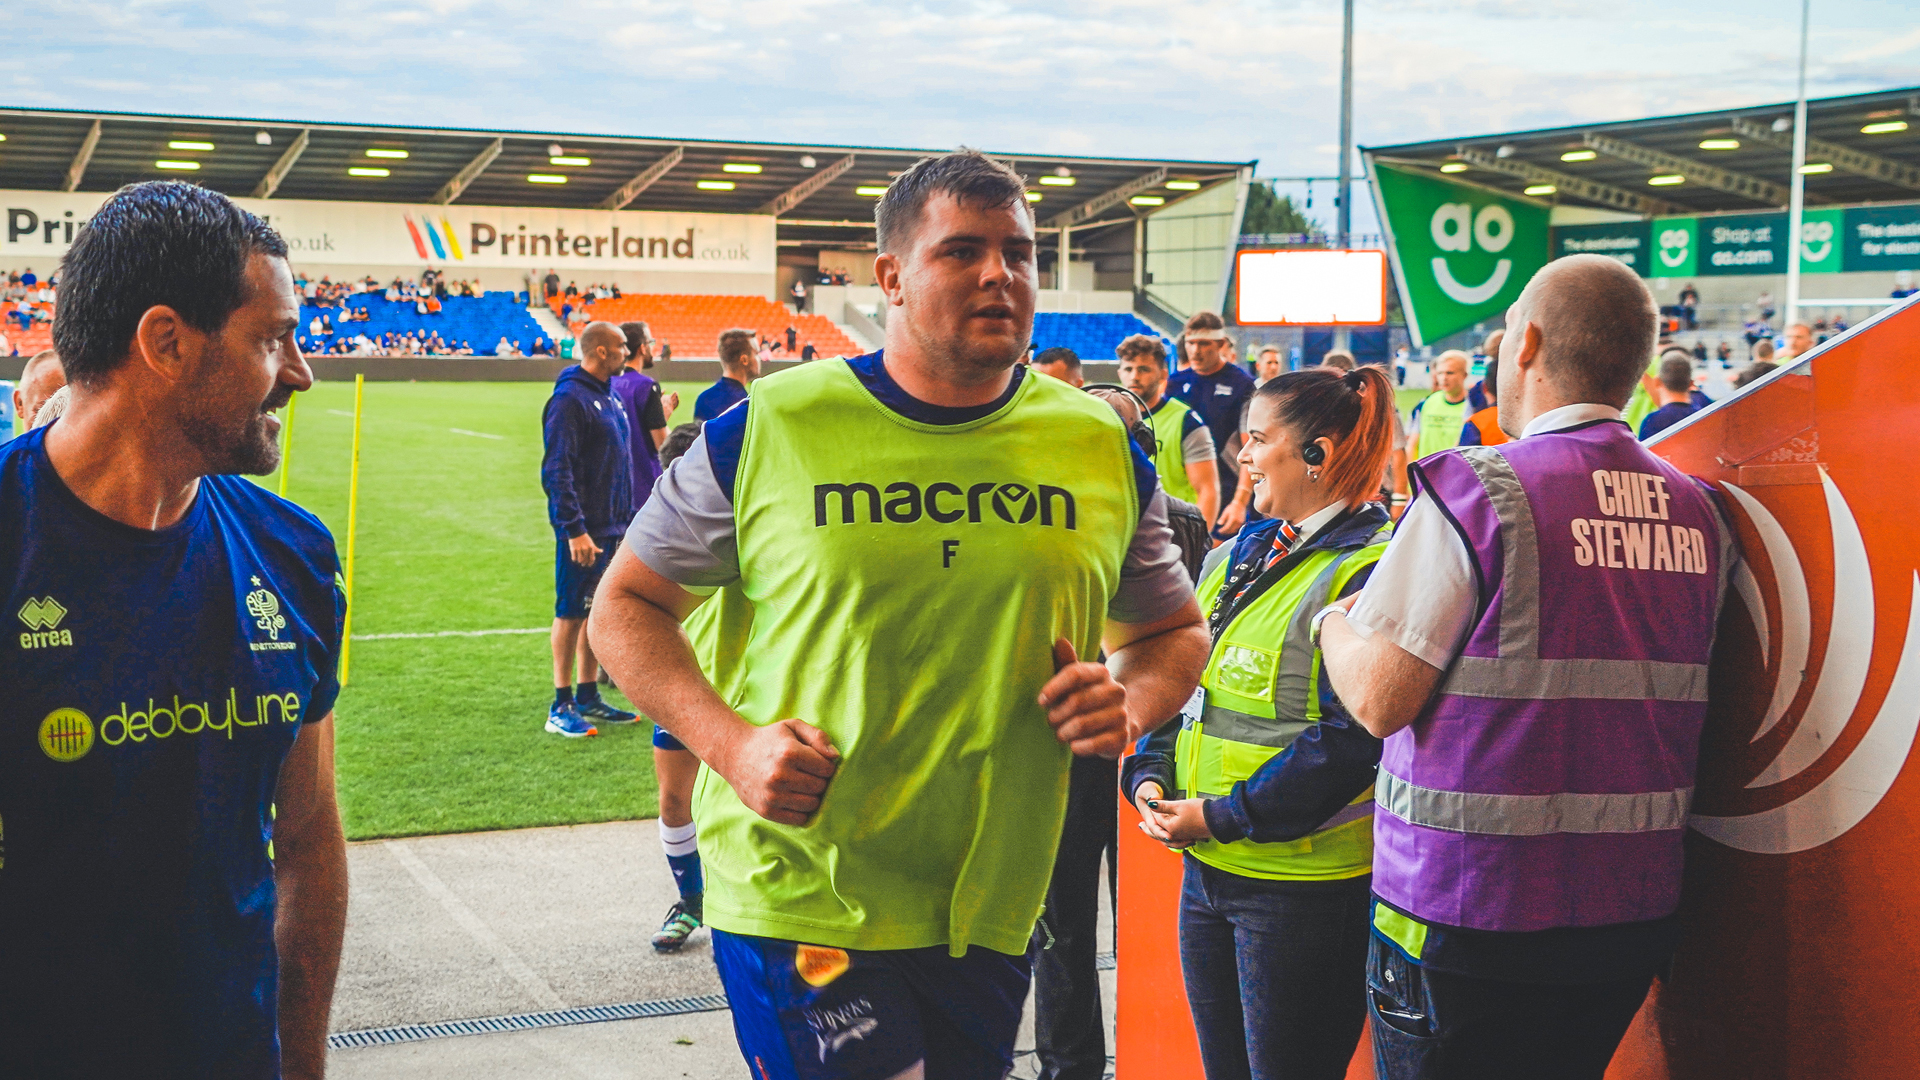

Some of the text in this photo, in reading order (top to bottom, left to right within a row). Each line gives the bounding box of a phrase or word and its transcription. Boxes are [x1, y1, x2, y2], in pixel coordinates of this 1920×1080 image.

[1431, 202, 1514, 253] ao
[1712, 226, 1752, 246] Shop
[1711, 249, 1773, 266] ao.com
[814, 482, 1076, 530] macron
[1592, 469, 1670, 520] CHIEF
[943, 540, 959, 568] F
[1570, 517, 1708, 575] STEWARD
